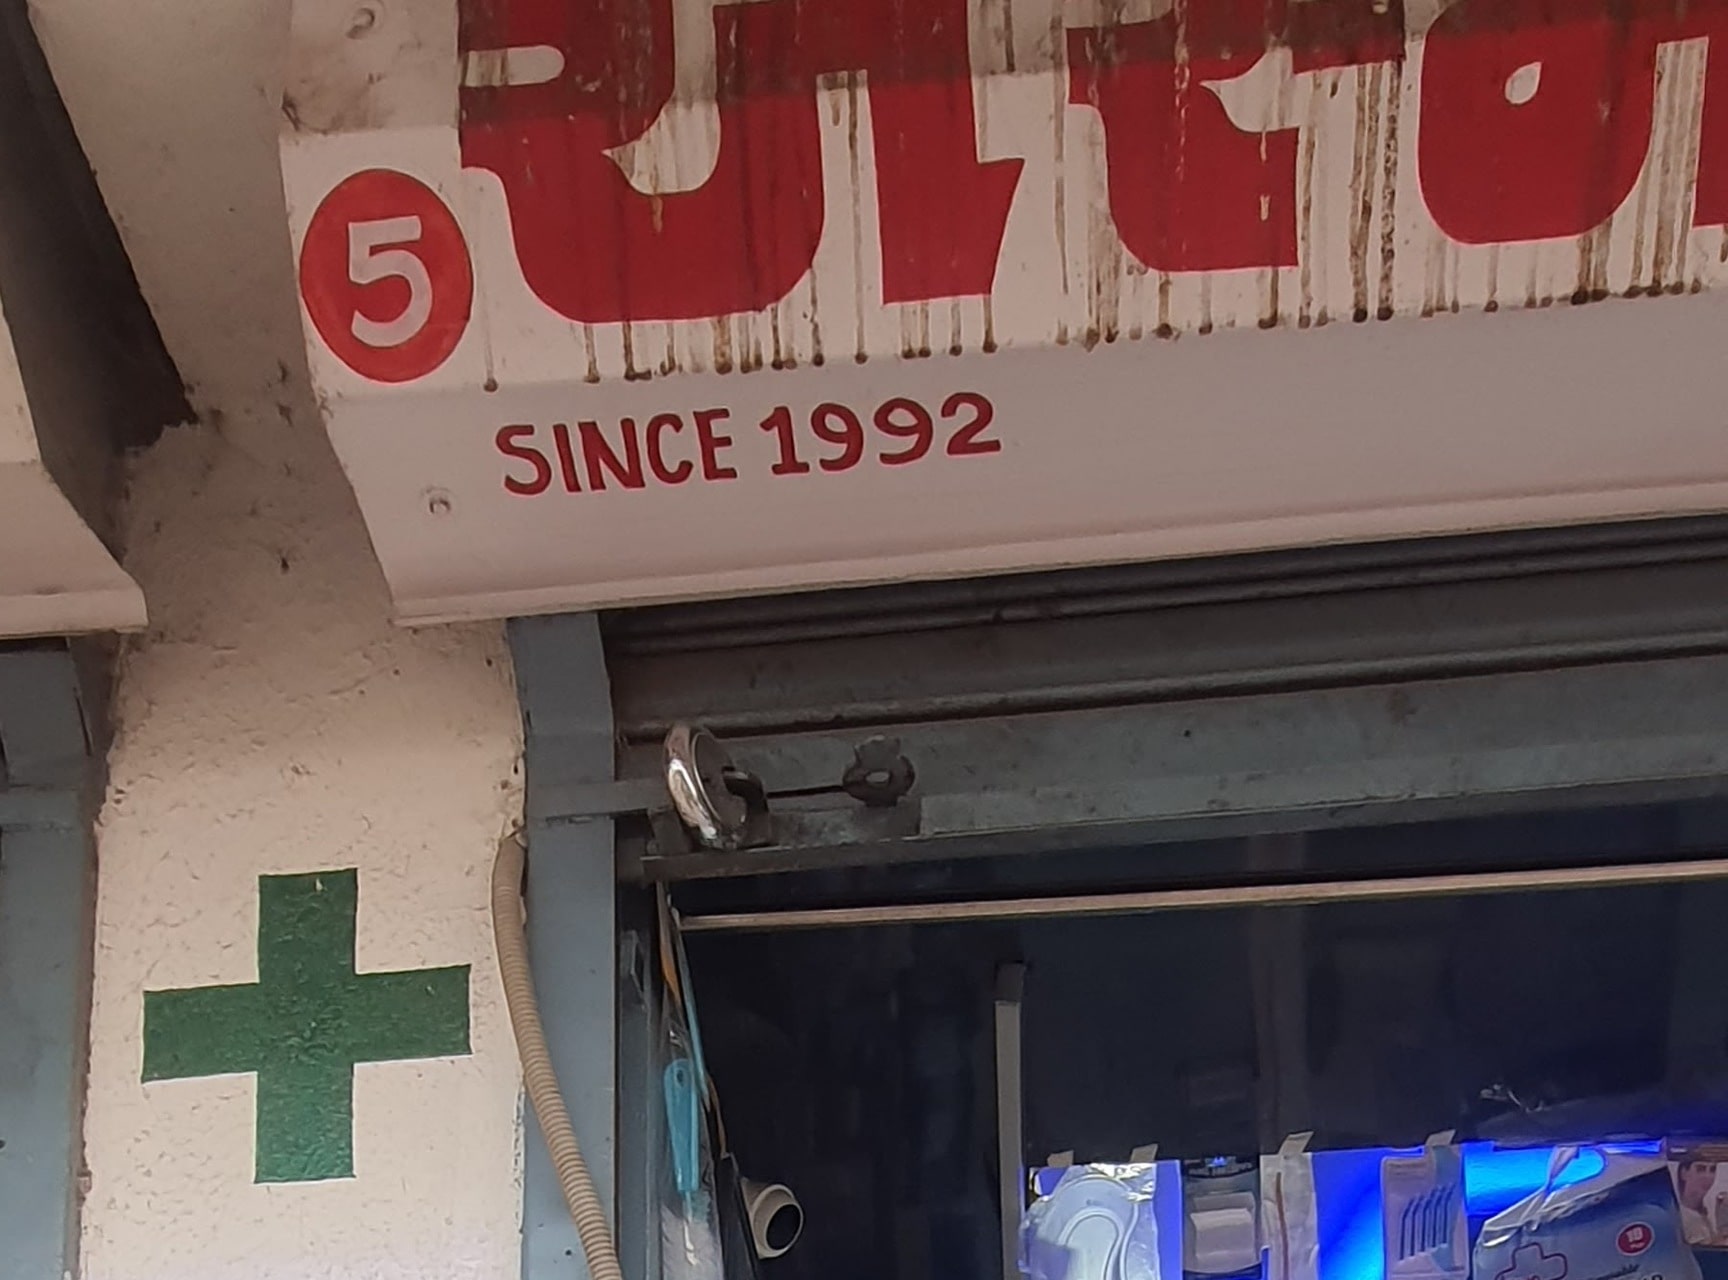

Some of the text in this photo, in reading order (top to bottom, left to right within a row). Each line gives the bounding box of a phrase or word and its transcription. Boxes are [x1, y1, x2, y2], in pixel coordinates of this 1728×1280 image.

[347, 215, 433, 348] 5
[495, 392, 1001, 496] SINCE 1992
